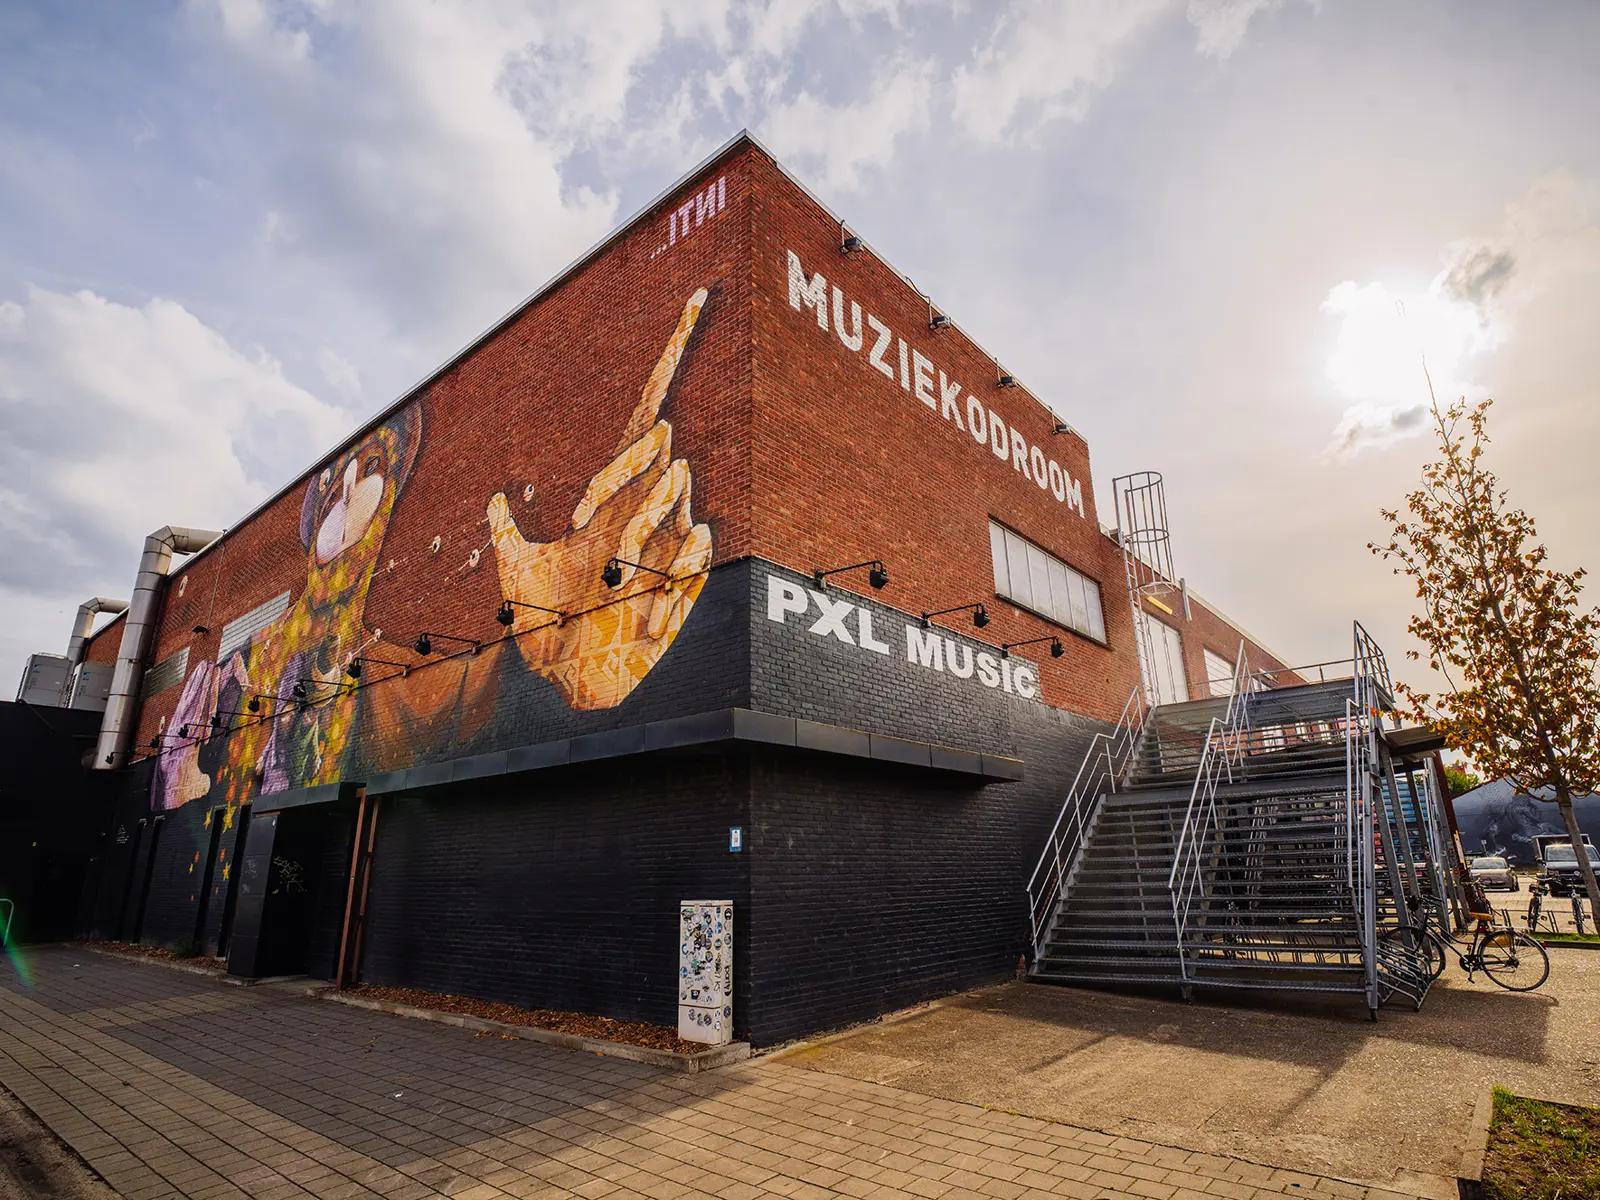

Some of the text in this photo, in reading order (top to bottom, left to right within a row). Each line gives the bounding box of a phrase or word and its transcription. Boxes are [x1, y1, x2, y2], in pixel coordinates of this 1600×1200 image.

[787, 248, 1085, 519] MUZIEKODROOM
[767, 574, 1037, 699] PXL MUSIC
